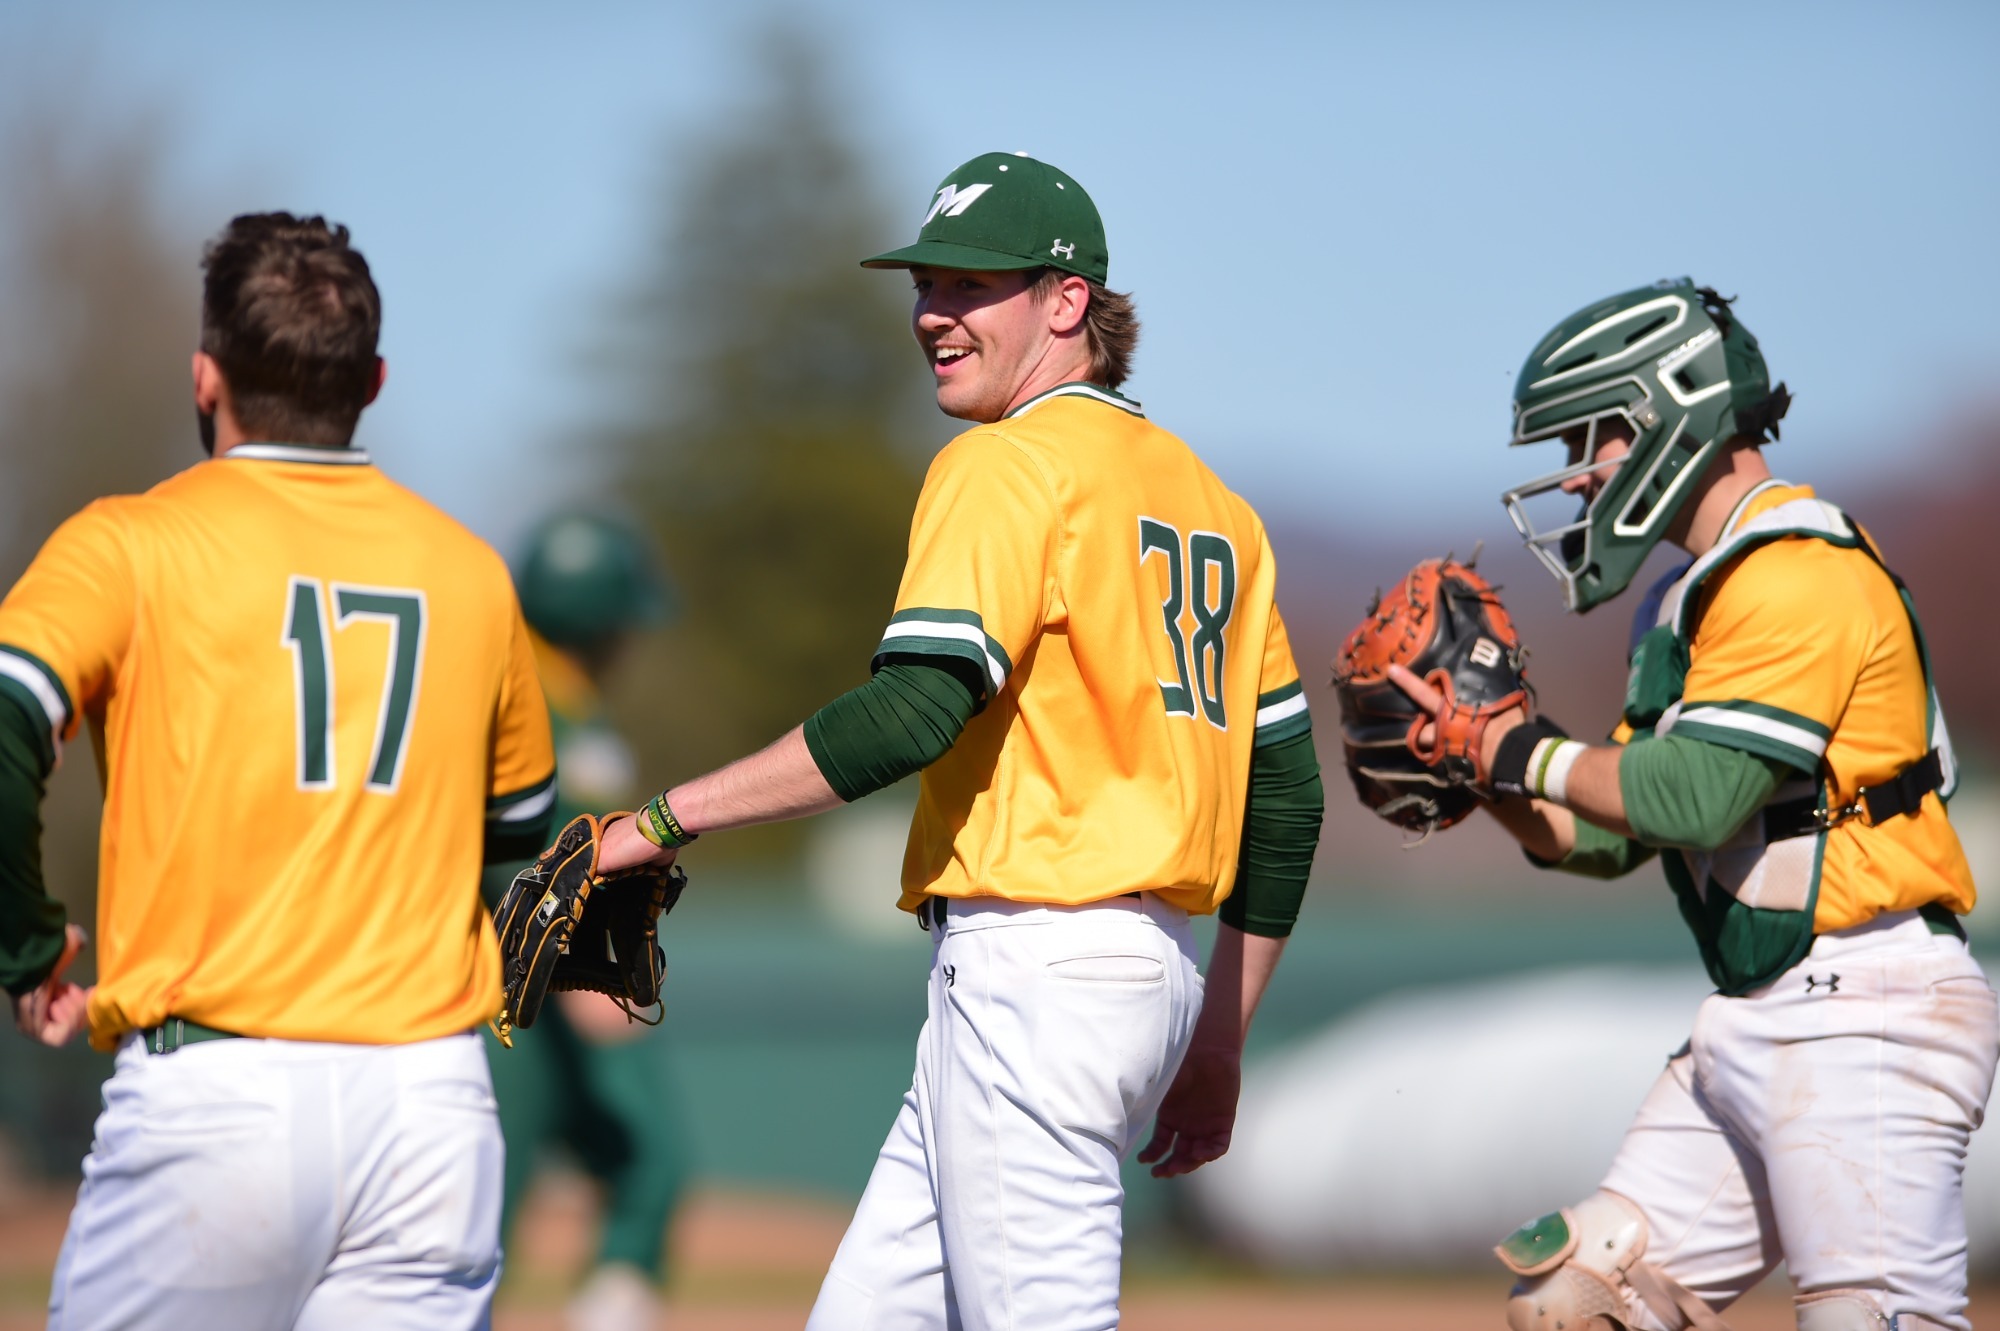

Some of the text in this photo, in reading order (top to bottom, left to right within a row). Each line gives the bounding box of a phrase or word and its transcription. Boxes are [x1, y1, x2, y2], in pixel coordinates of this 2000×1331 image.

[921, 183, 993, 228] M
[279, 573, 428, 796] 17
[1137, 515, 1237, 732] 38
